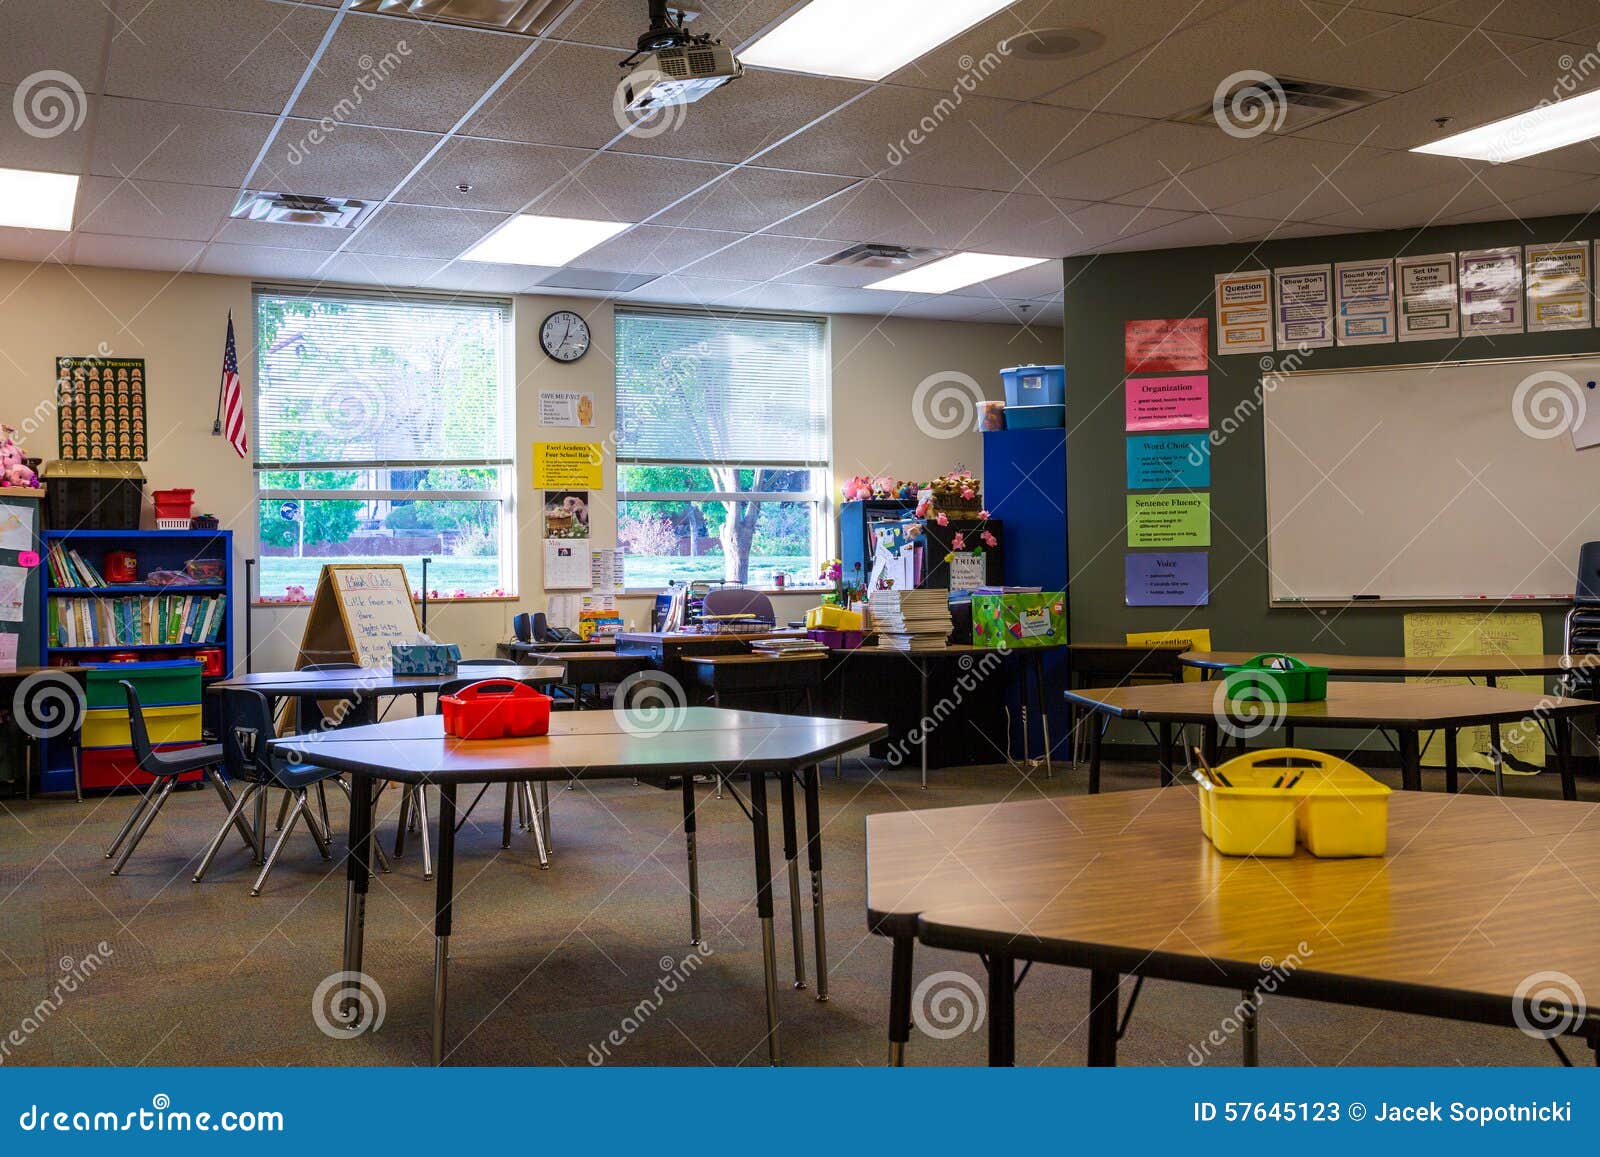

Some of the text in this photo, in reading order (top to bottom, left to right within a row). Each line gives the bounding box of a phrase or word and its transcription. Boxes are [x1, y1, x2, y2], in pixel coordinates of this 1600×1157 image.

[1225, 283, 1262, 293] Question
[1141, 384, 1193, 393] Organization
[1166, 441, 1194, 449] Choic
[1135, 499, 1202, 508] Sentence Fluency
[955, 558, 981, 566] THINK
[1156, 559, 1177, 567] Voice
